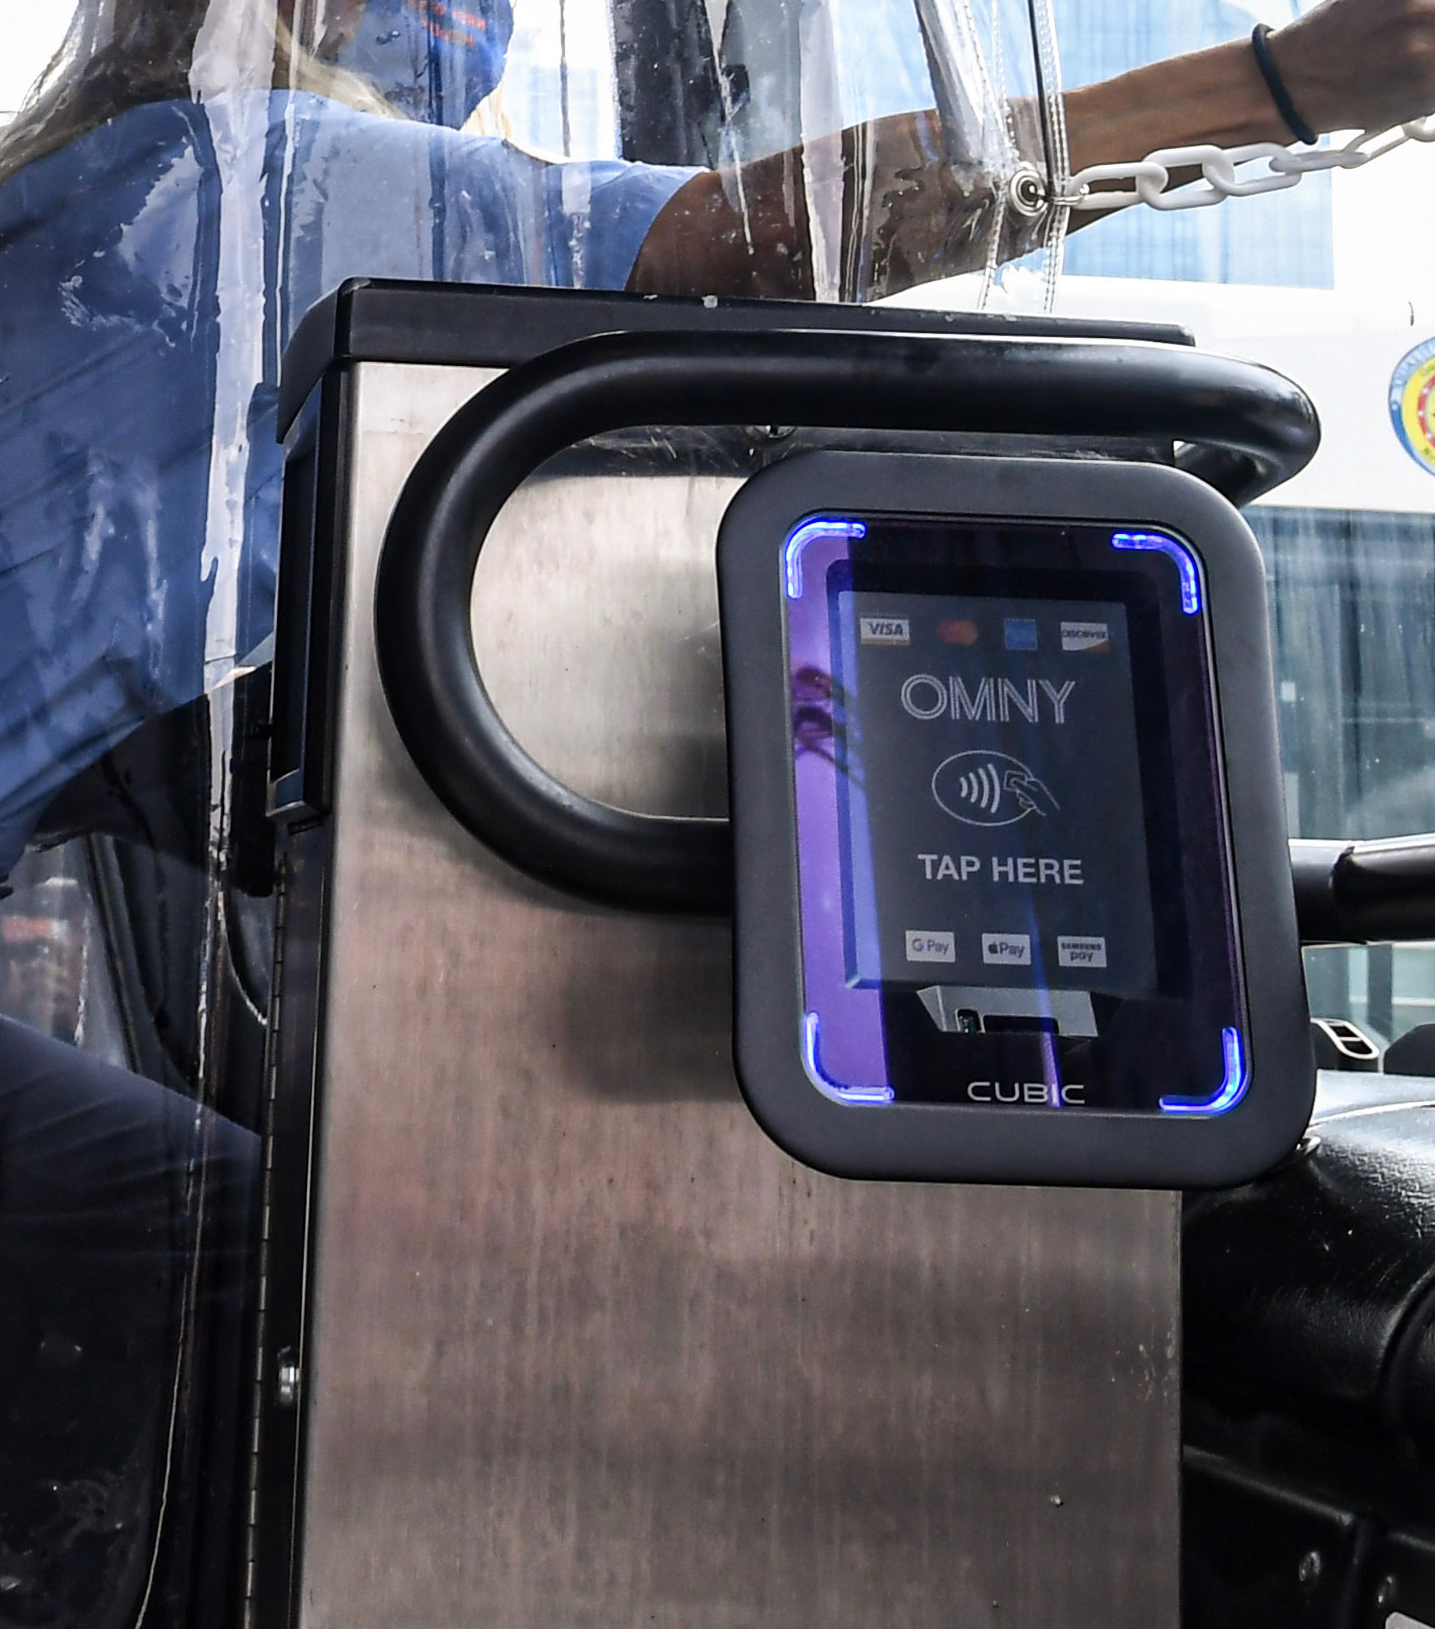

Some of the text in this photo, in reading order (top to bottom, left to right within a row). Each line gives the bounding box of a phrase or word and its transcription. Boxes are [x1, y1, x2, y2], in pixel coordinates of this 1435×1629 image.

[869, 623, 904, 635] VISA
[1063, 629, 1107, 638] DISCOVER
[901, 674, 1075, 724] OMNY
[918, 854, 1084, 885] TAP HERE
[928, 939, 949, 954] Pay
[1000, 942, 1024, 958] Pay
[1061, 943, 1101, 951] SAMSUNG
[1070, 951, 1093, 962] pay
[967, 1082, 1085, 1104] CUBIC
